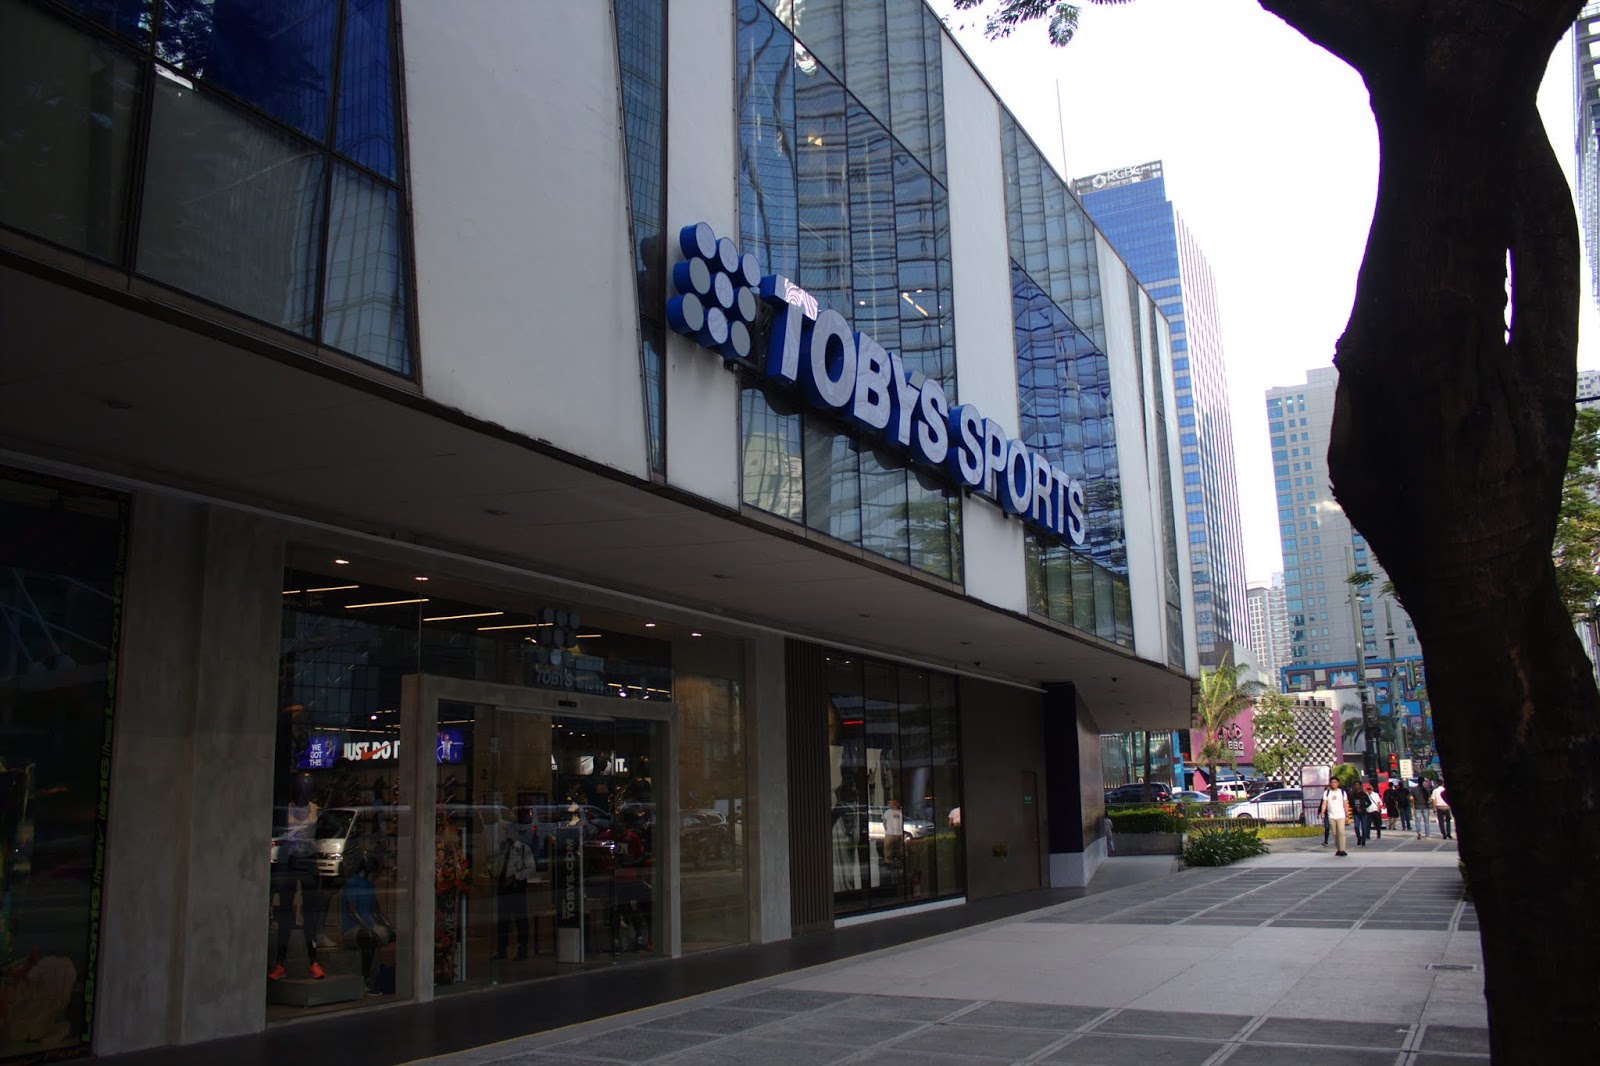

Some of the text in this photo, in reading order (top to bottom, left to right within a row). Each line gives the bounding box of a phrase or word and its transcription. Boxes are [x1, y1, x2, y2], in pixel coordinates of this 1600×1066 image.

[1107, 165, 1143, 181] RCBC
[958, 403, 1086, 546] SPORTS
[310, 751, 322, 759] GOT
[343, 742, 370, 761] JUST
[372, 740, 391, 760] DO
[566, 839, 576, 919] TOBYS.COM
